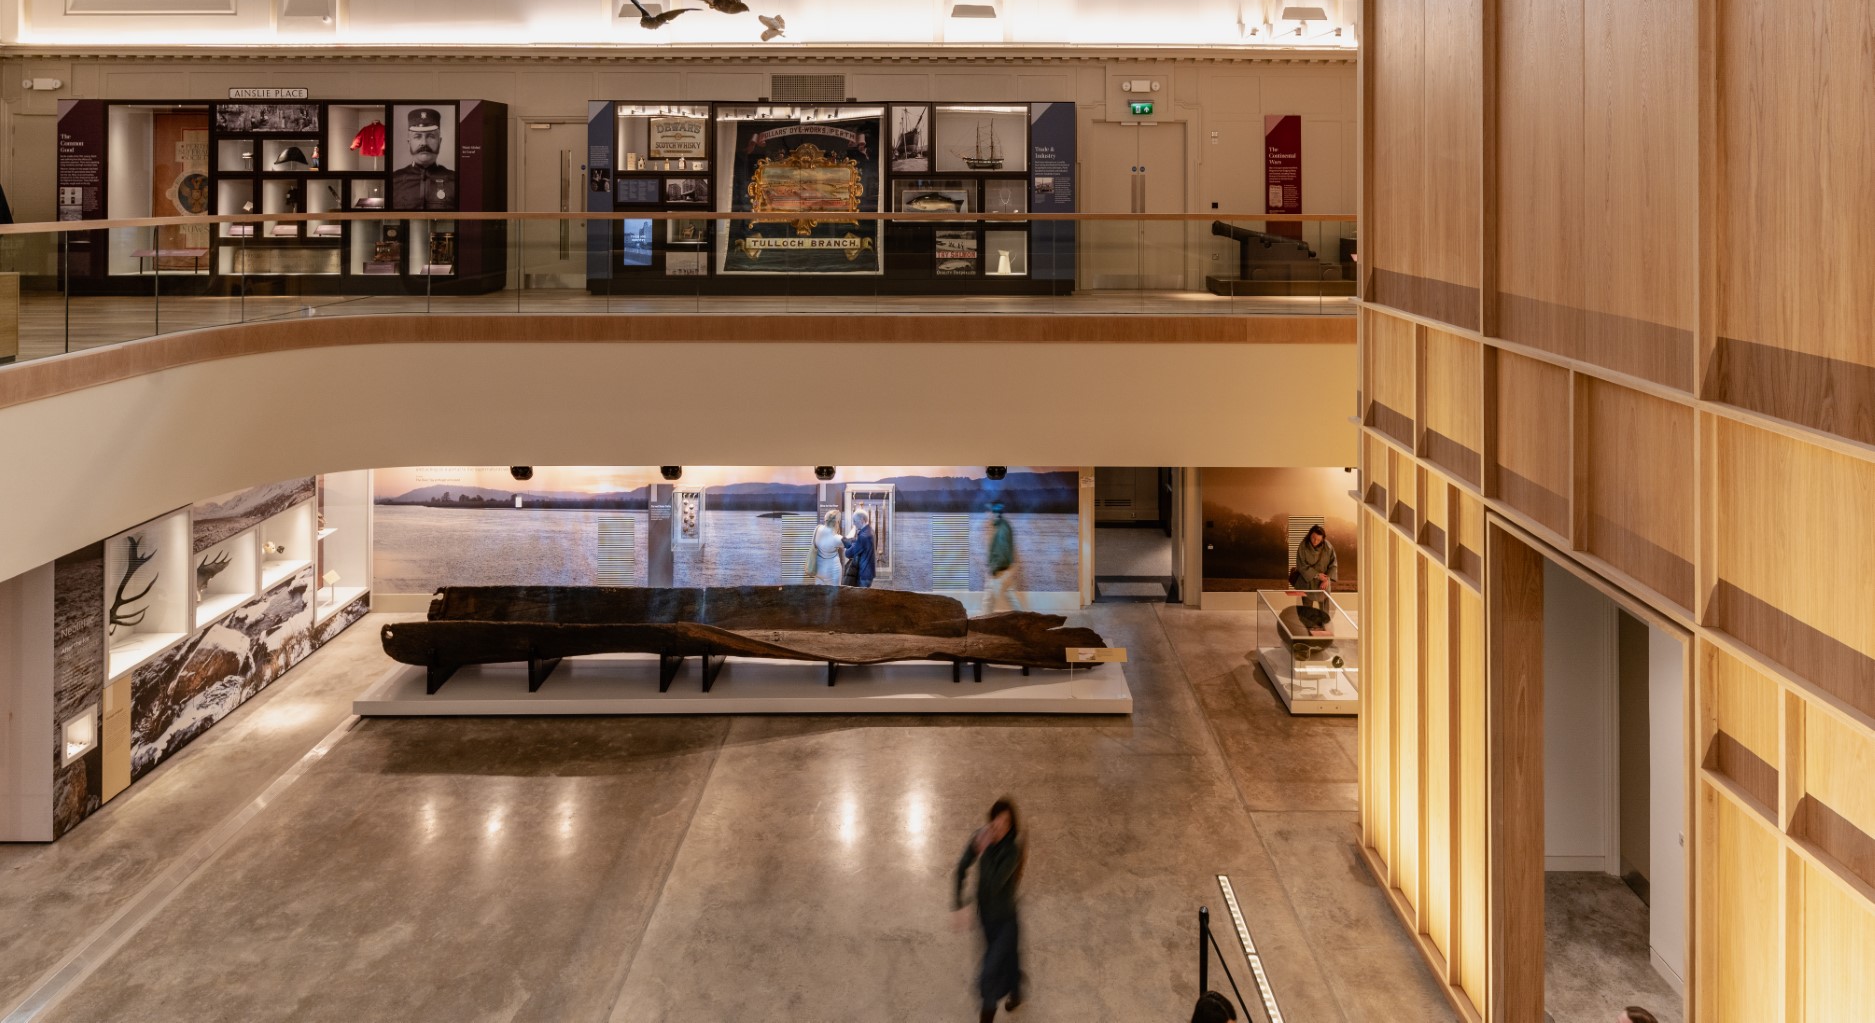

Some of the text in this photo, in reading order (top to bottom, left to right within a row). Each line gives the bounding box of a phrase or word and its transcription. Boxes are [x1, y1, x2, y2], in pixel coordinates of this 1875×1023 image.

[234, 89, 304, 98] AINSLIE PLACE
[830, 128, 855, 140] PERTH
[677, 141, 701, 149] WHISKY
[751, 239, 804, 247] TULLOCH
